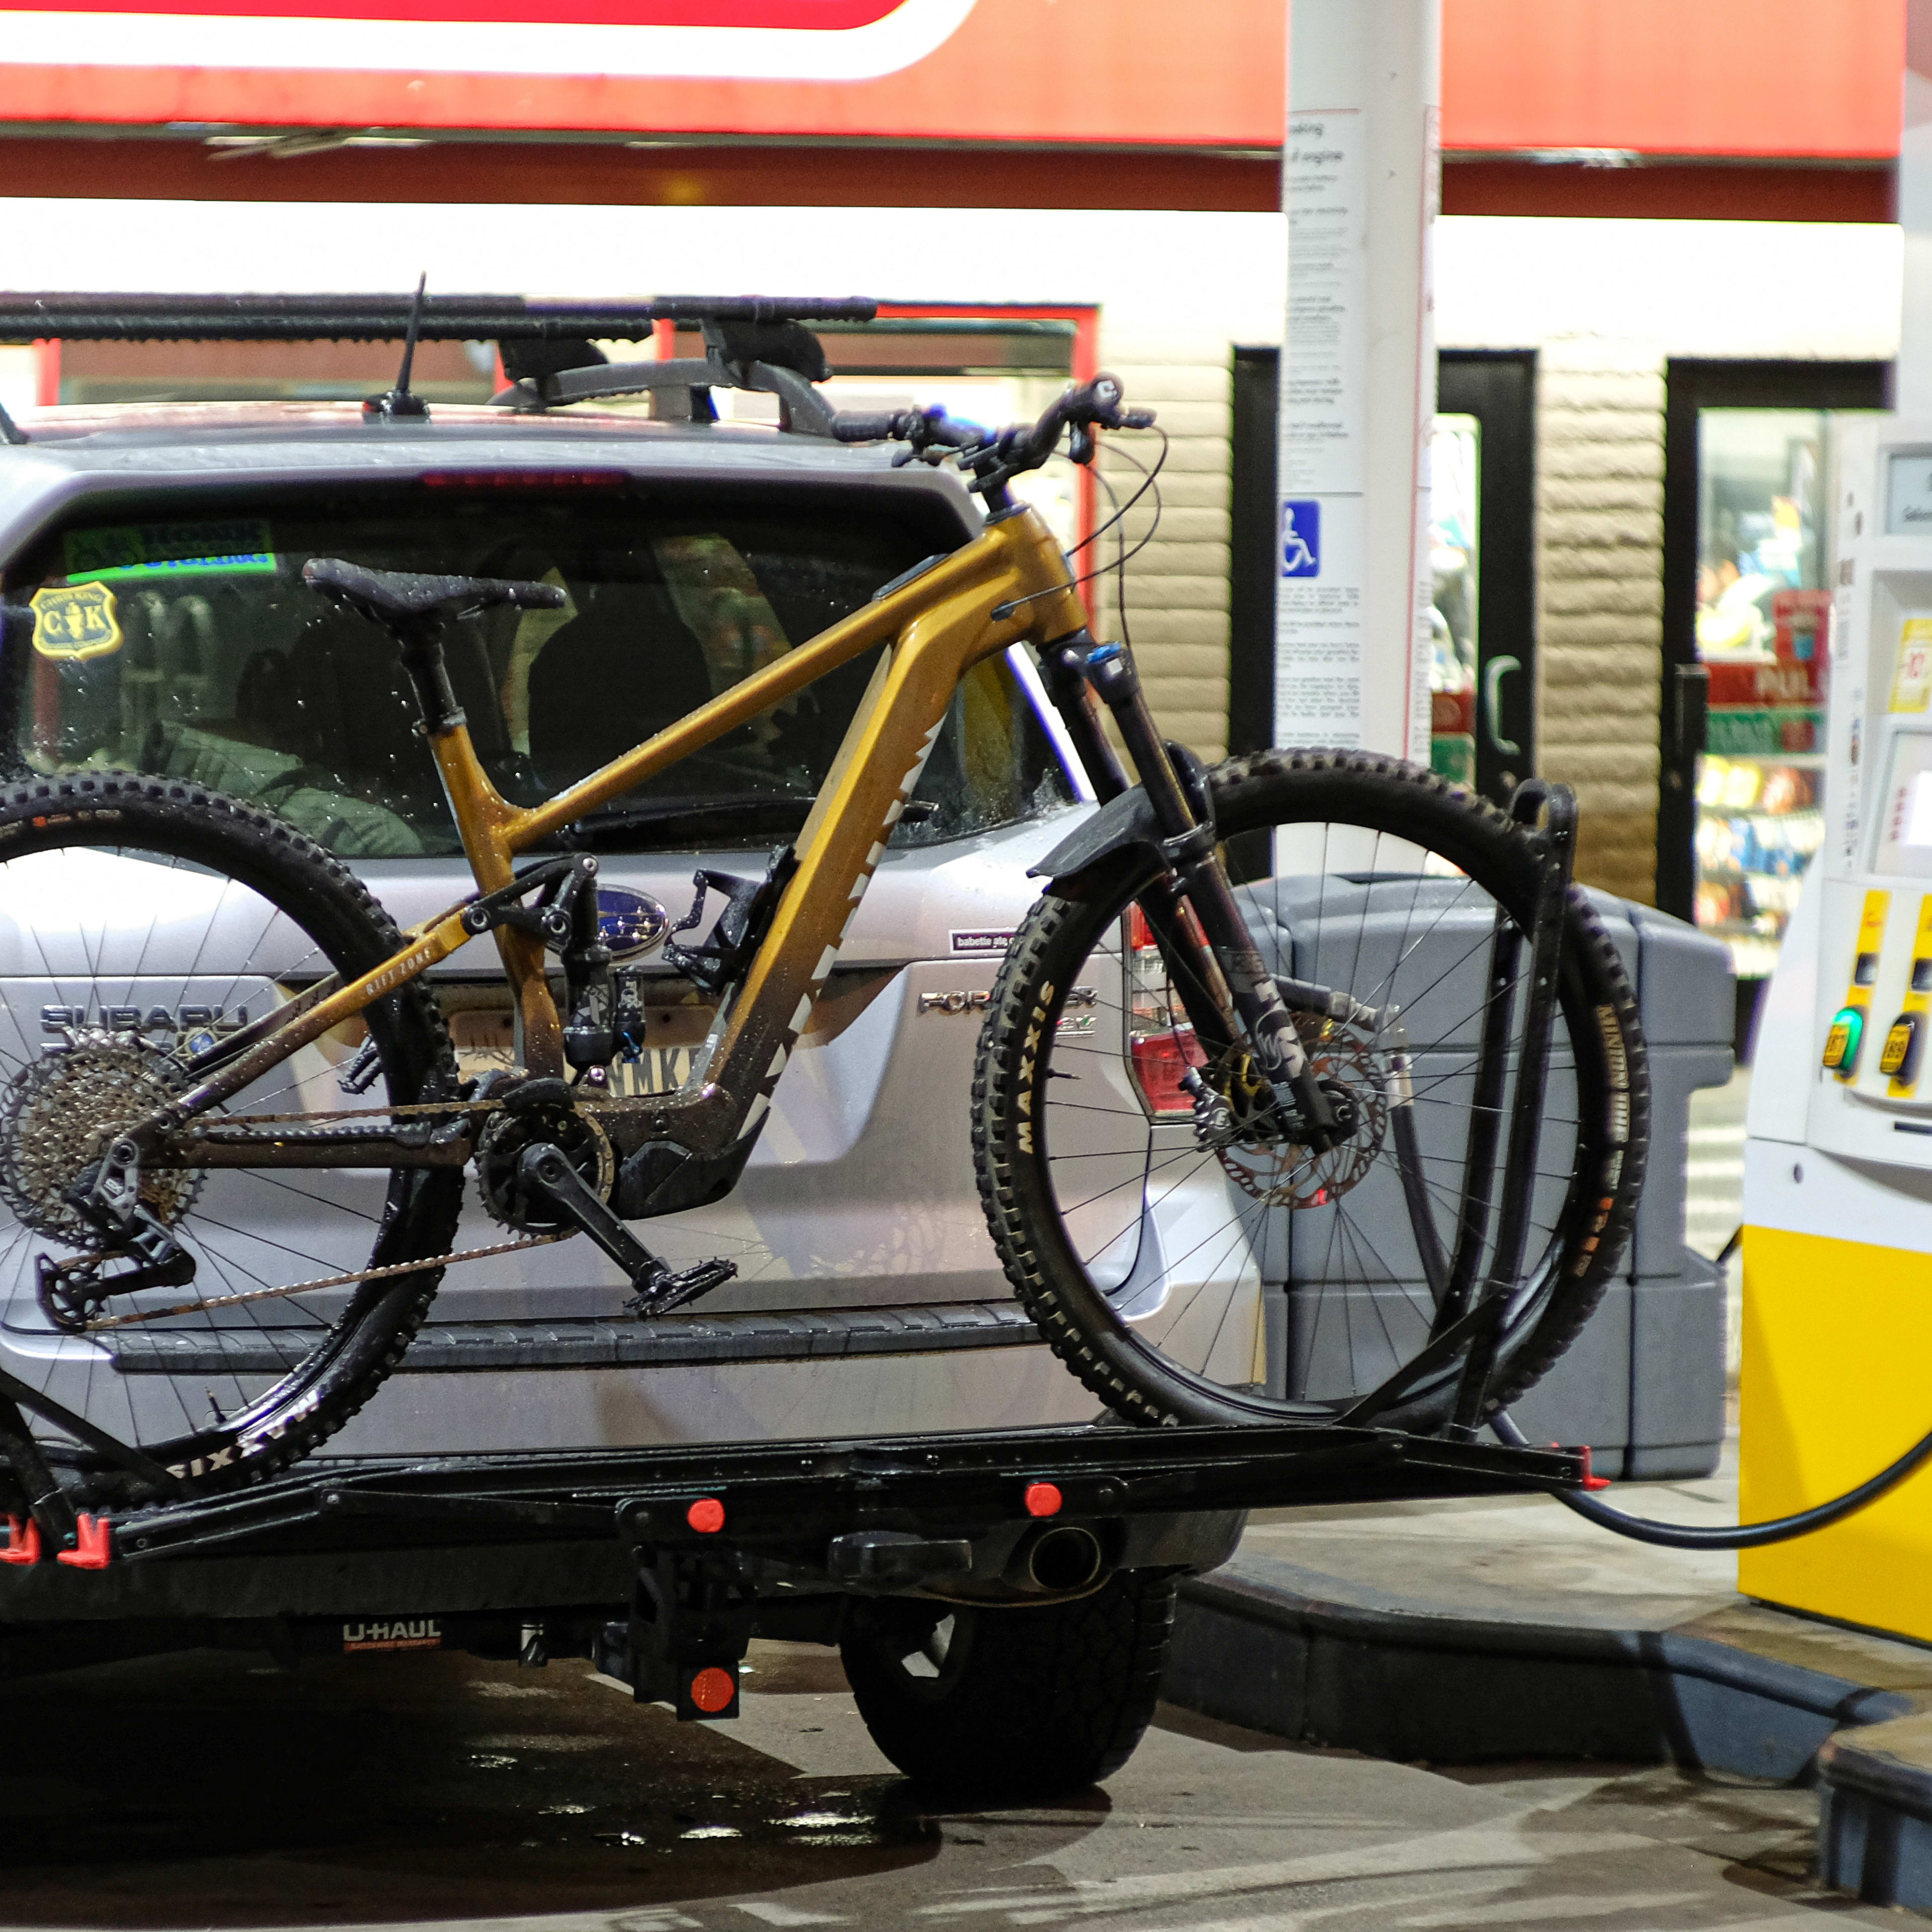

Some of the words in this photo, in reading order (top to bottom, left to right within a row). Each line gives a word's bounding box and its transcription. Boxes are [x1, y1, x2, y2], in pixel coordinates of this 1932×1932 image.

[83, 605, 106, 629] K
[366, 970, 395, 996] RIFT
[399, 947, 431, 976] ZONE
[40, 1004, 247, 1032] SUBARU
[1017, 980, 1055, 1154] MAXXIS
[343, 1618, 442, 1642] U-HAUL
